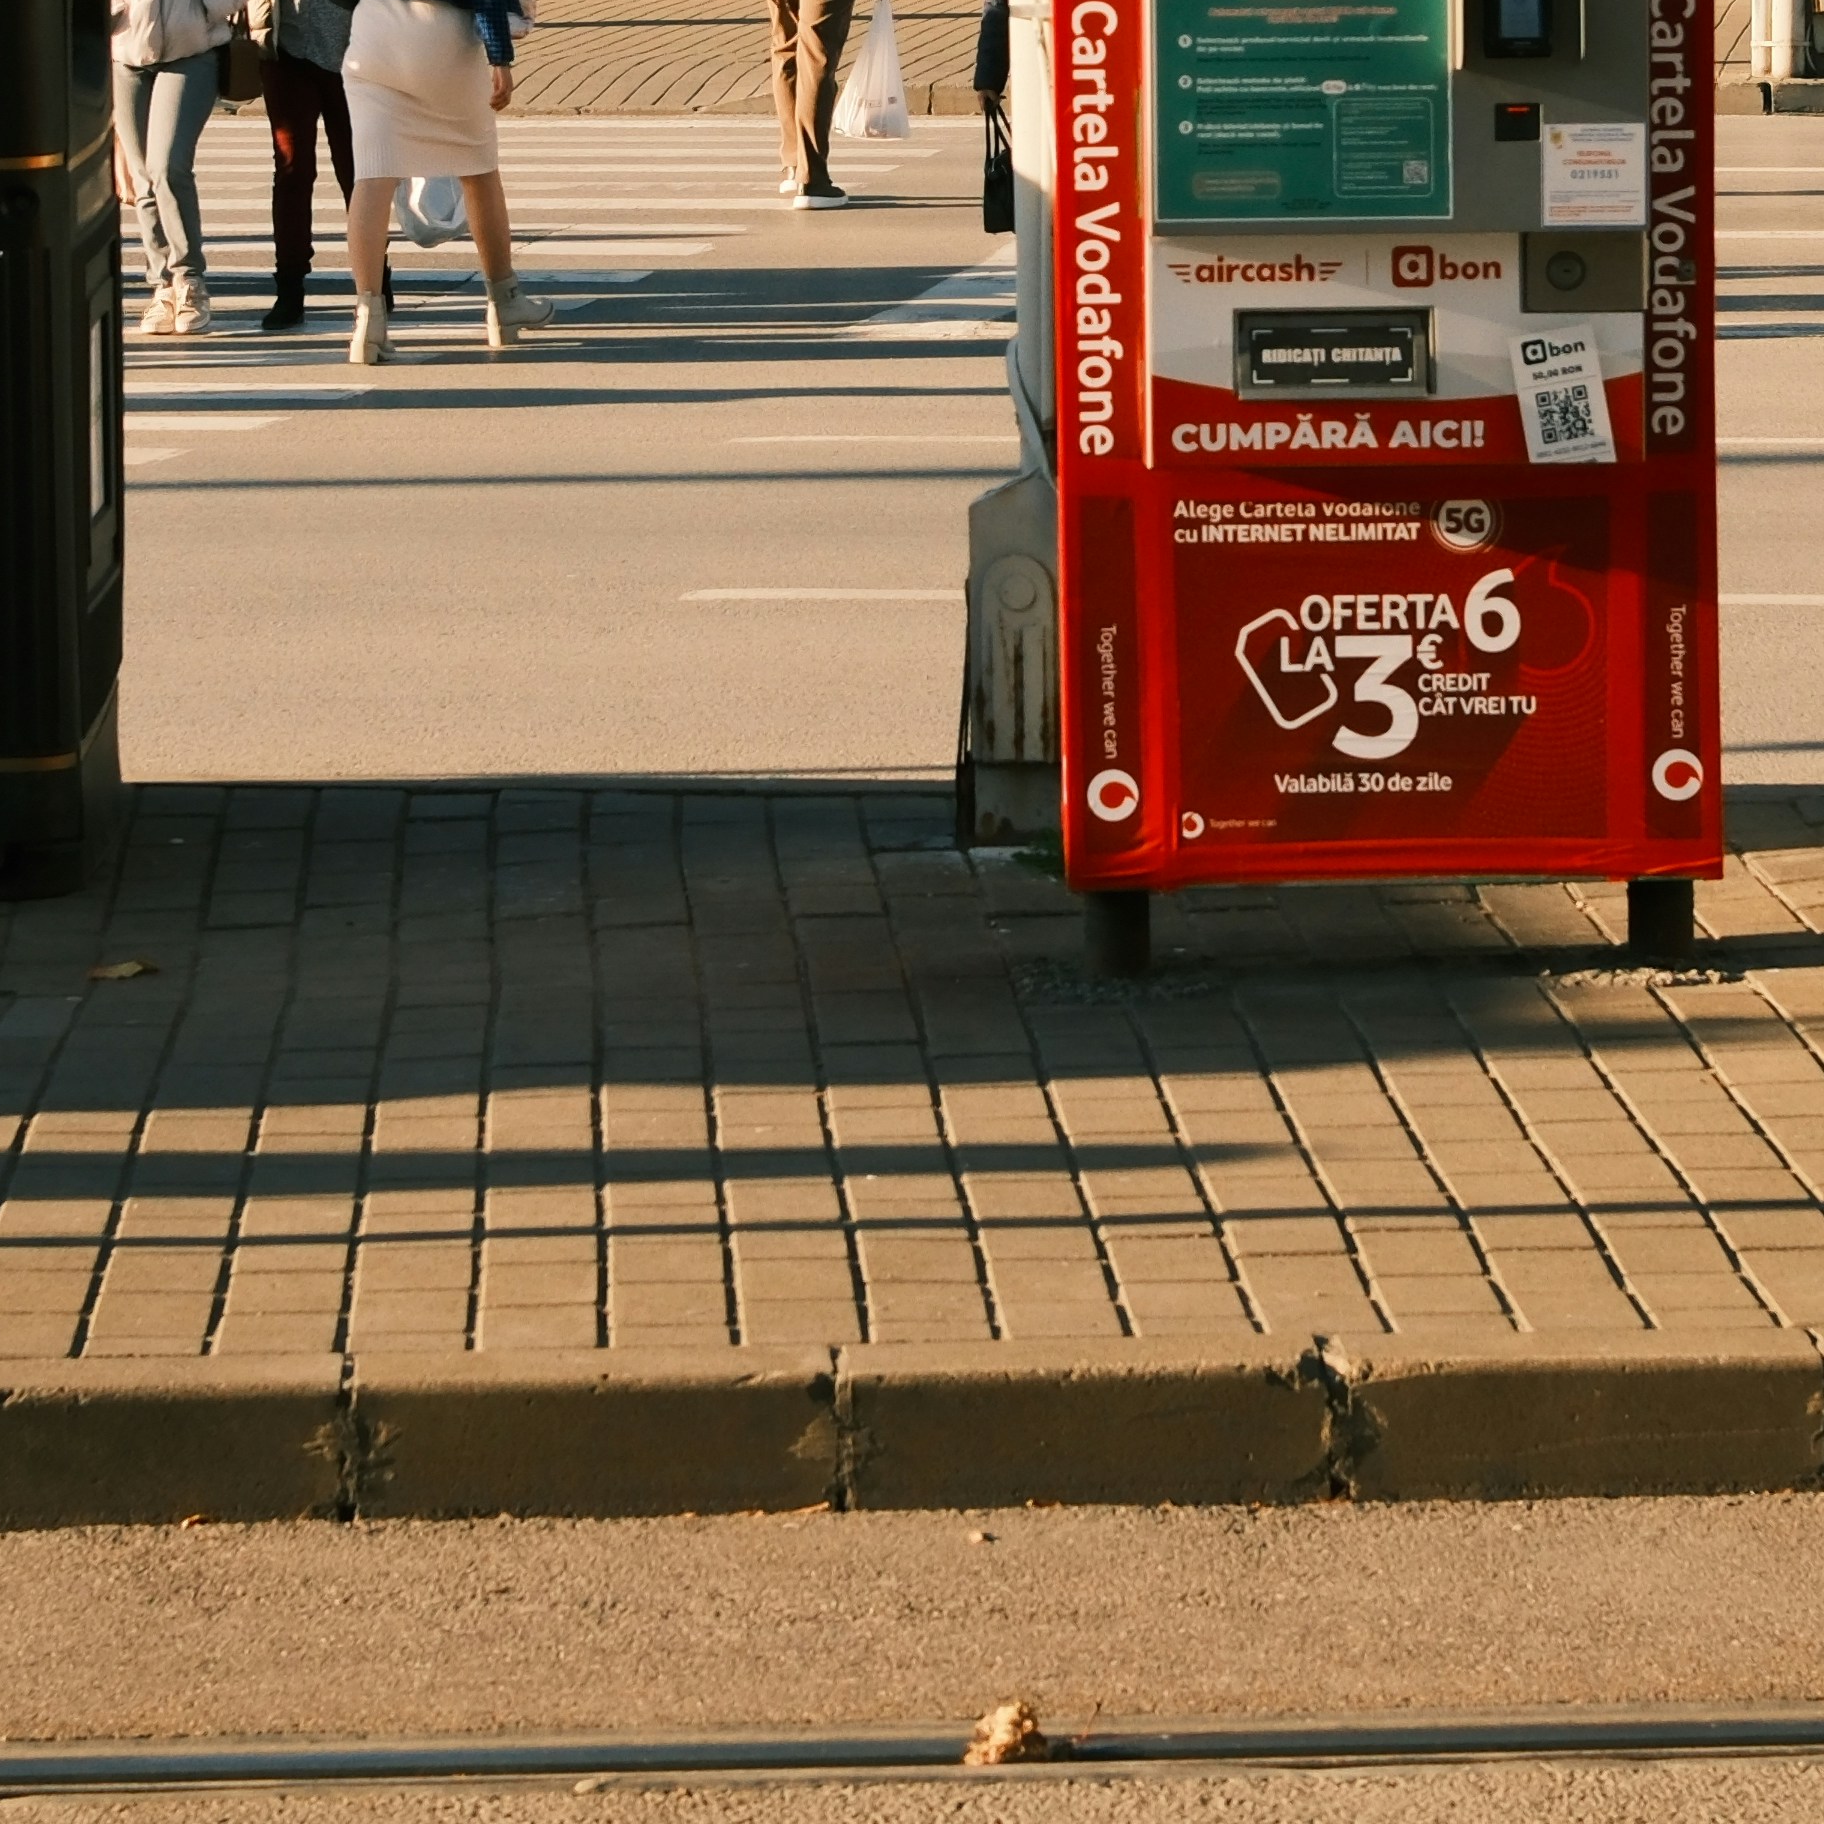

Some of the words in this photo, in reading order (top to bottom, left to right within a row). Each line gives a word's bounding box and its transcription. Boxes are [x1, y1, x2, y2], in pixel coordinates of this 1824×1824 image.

[1071, 3, 1120, 192] Cartela
[1194, 253, 1316, 283] aircash
[1650, 185, 1697, 436] Vodafone
[1074, 201, 1124, 457] Vodafone
[1172, 412, 1379, 453] CUMPĂRĂ
[1388, 419, 1485, 449] AICI!
[1173, 500, 1235, 523] Alege
[1239, 500, 1316, 518] Cartela
[1445, 507, 1485, 534] 5G
[1173, 527, 1198, 543] cu
[1201, 523, 1307, 543] INTERNET
[1309, 522, 1421, 542] NELIMITAT
[1299, 593, 1460, 631] OFERTA
[1463, 567, 1522, 653] 6
[1665, 604, 1687, 678] Together
[1097, 623, 1118, 699] Together
[1280, 635, 1335, 673] LA
[1332, 635, 1420, 760] 3
[1416, 634, 1444, 671] €
[1418, 673, 1491, 692] CREDIT
[1670, 681, 1685, 706] we
[1103, 701, 1117, 726] we
[1418, 693, 1457, 716] CÂT
[1459, 696, 1506, 714] VREI
[1511, 696, 1537, 715] TU
[1670, 709, 1685, 739] can
[1104, 729, 1118, 759] can
[1274, 772, 1355, 794] Valabilă
[1358, 773, 1385, 792] 30
[1387, 773, 1412, 792] de
[1415, 772, 1453, 792] zile
